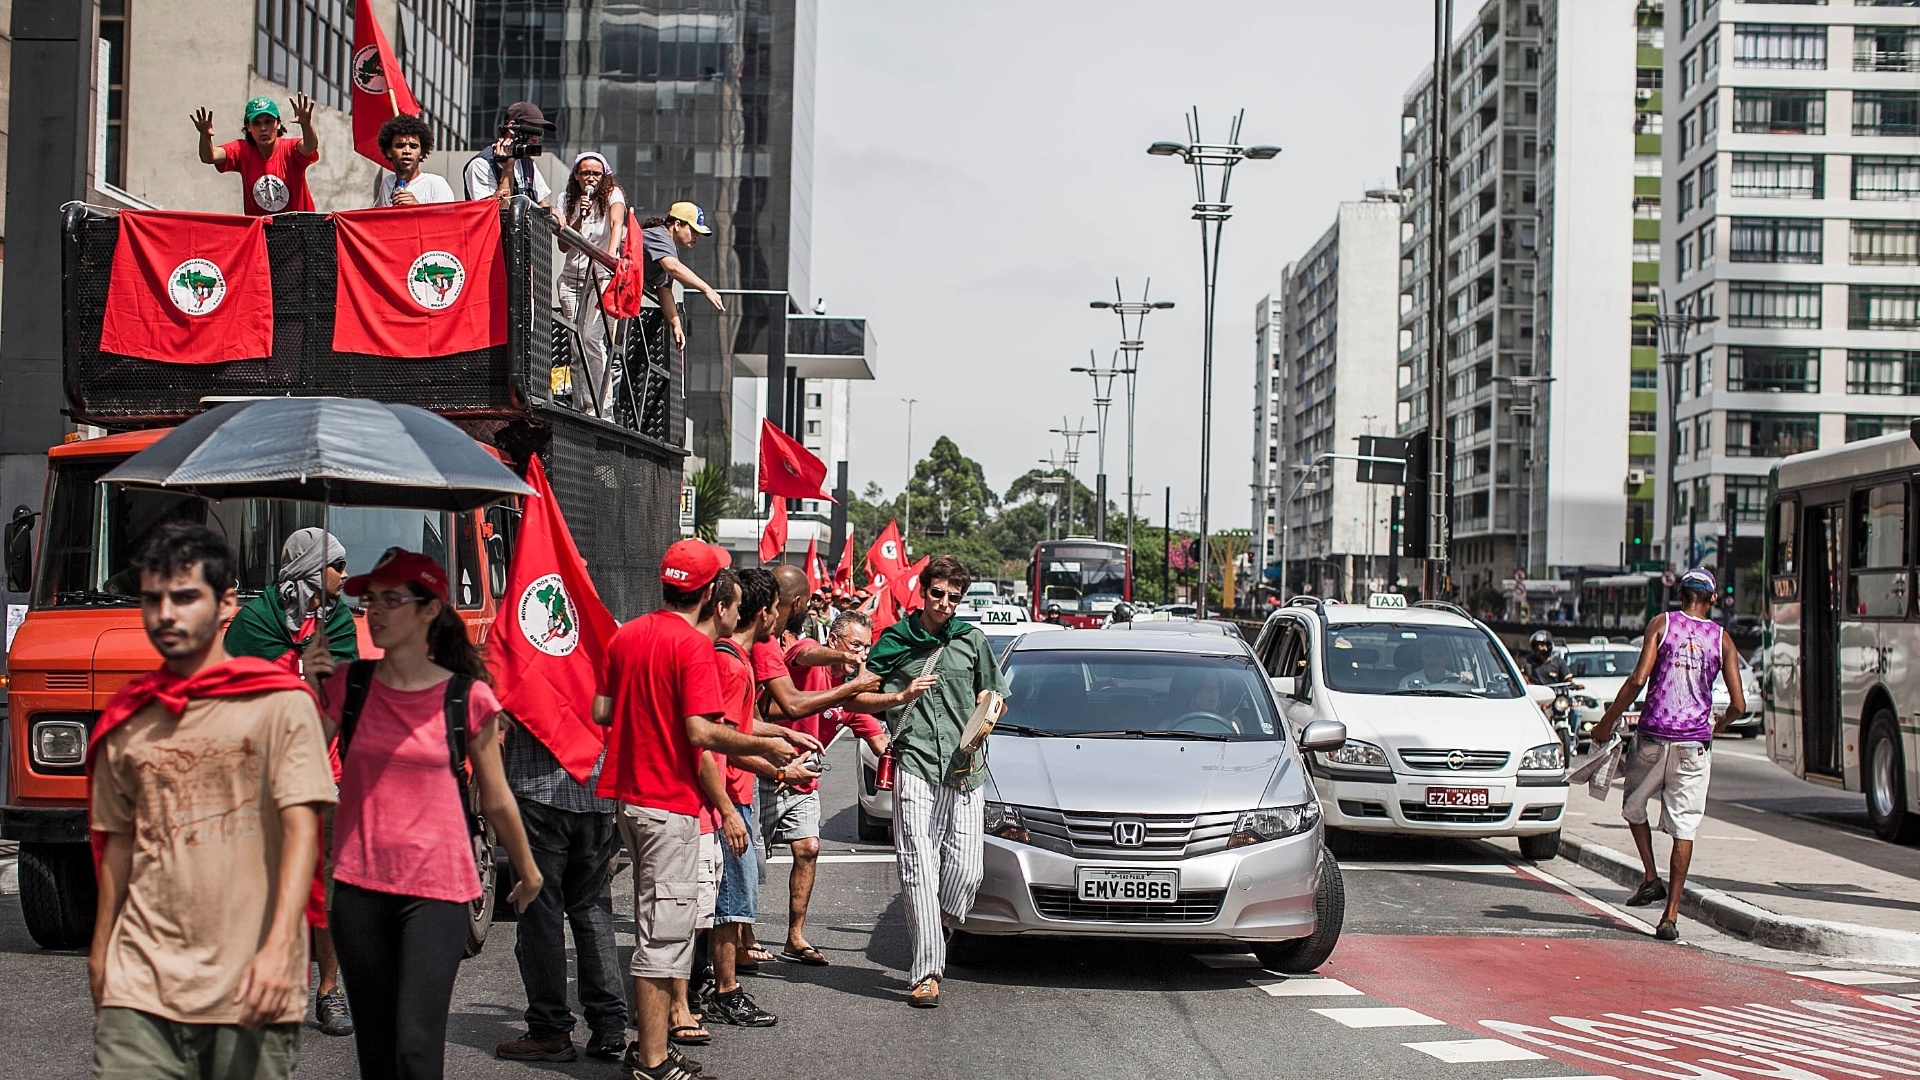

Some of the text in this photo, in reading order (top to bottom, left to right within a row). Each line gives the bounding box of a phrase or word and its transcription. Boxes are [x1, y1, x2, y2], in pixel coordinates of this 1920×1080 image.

[665, 567, 689, 581] MST
[521, 578, 549, 621] MOVIMENTO DOS
[973, 598, 989, 606] TAXI
[1373, 595, 1404, 607] TAXI
[986, 611, 1011, 622] TAXI
[529, 634, 549, 651] BRASIL
